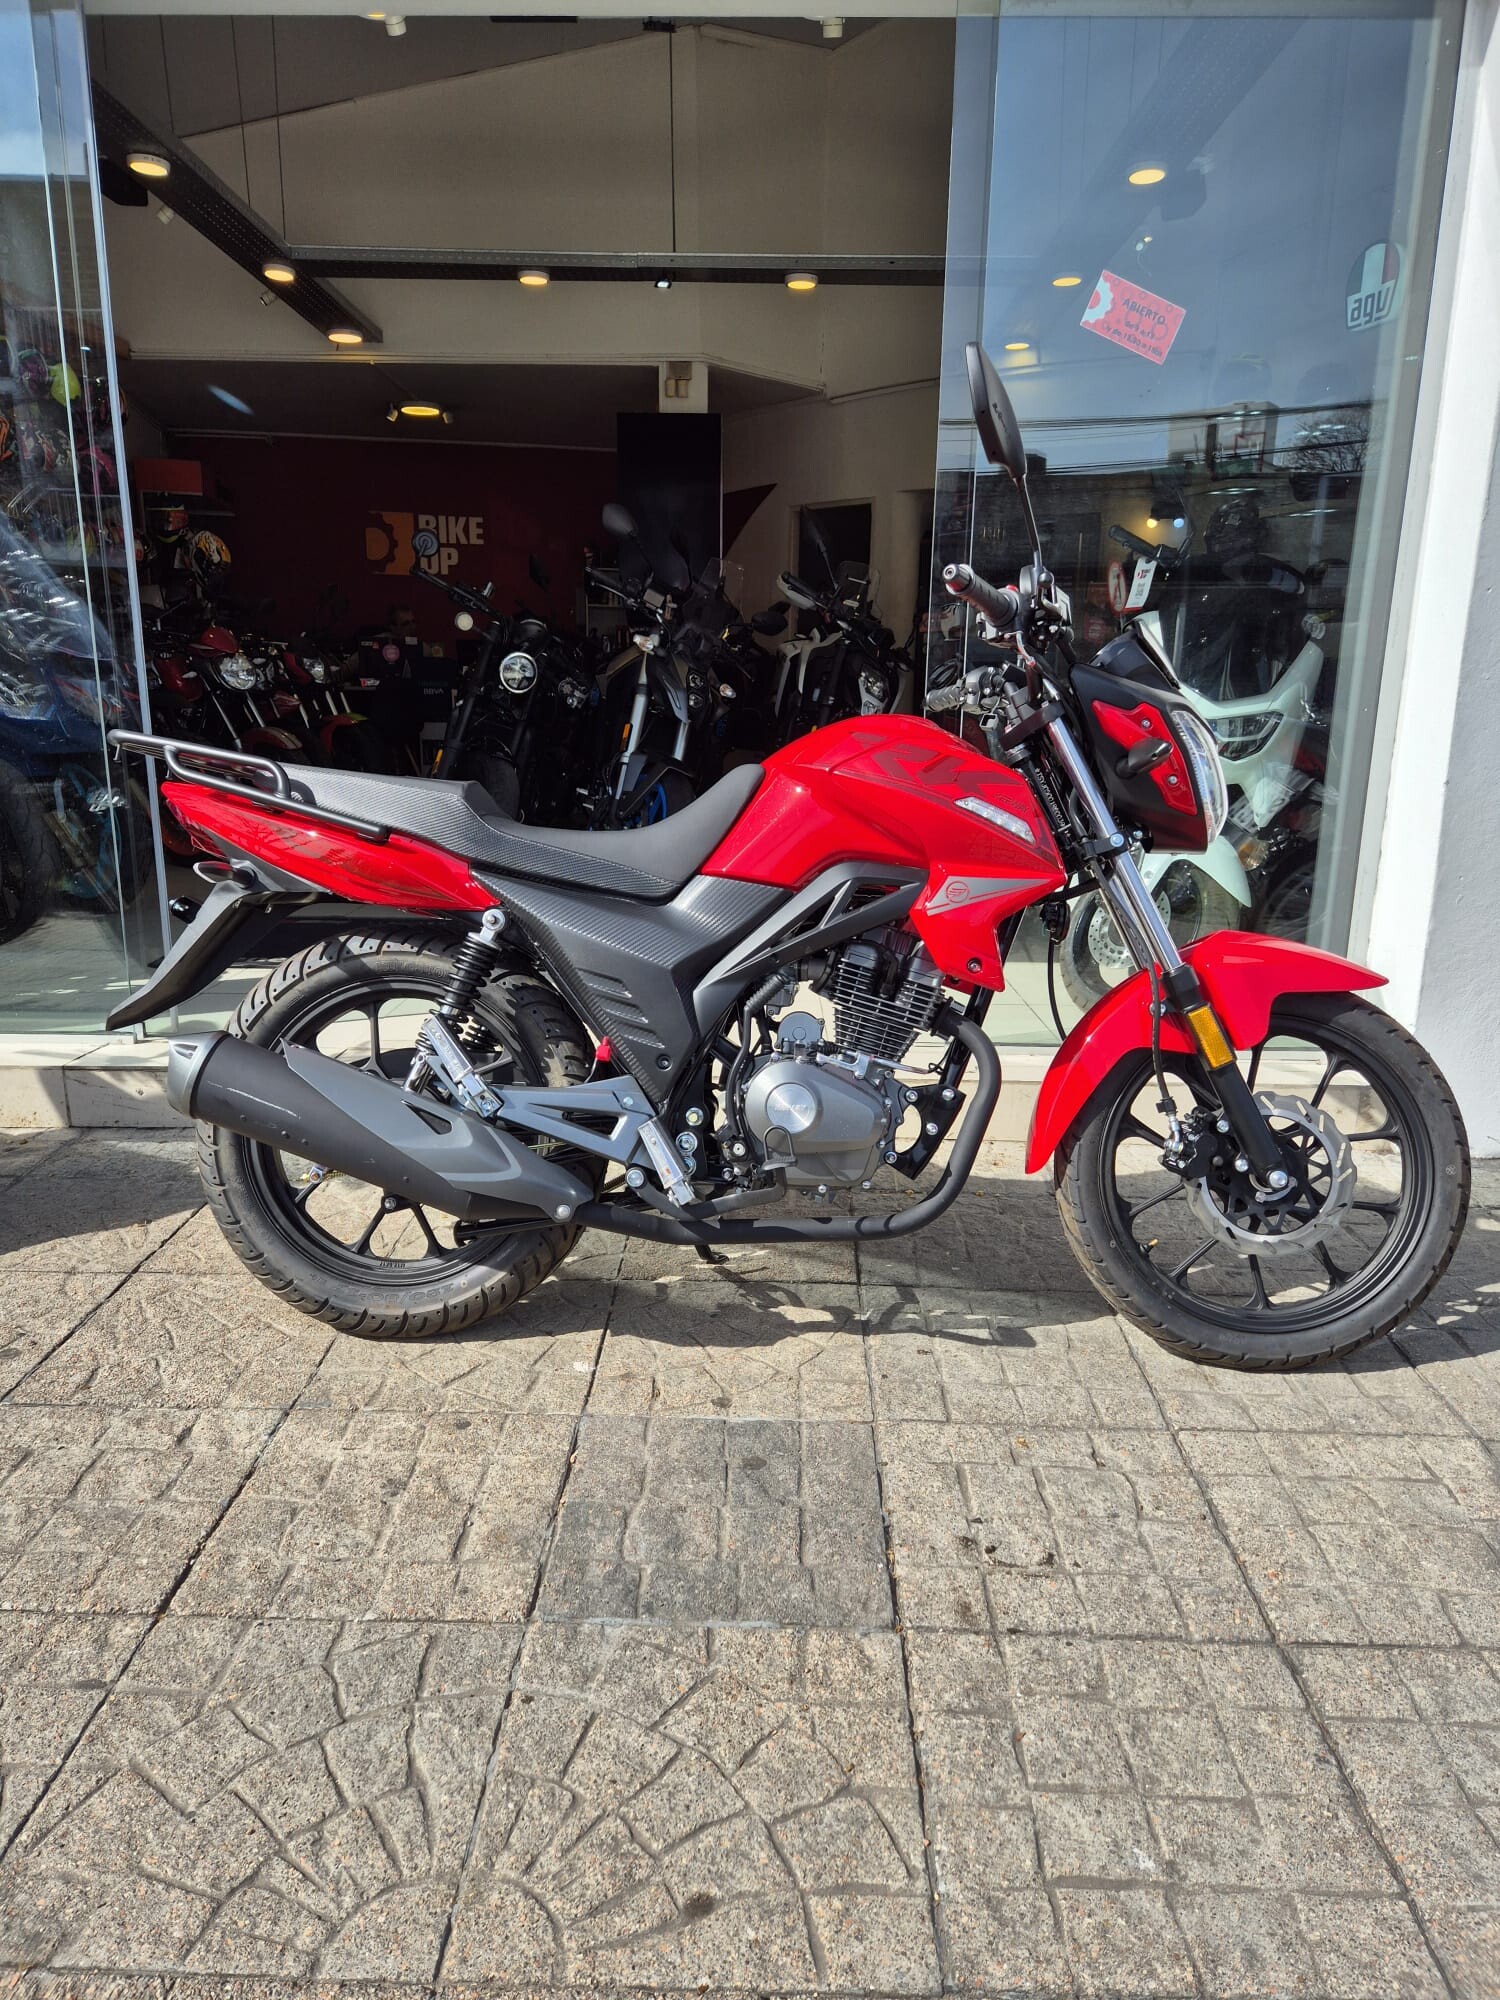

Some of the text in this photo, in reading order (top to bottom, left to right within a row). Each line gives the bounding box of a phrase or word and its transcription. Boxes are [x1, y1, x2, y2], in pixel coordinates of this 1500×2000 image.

[1121, 298, 1166, 325] ABIERTO
[1350, 286, 1393, 325] agv
[418, 514, 484, 544] BIKE
